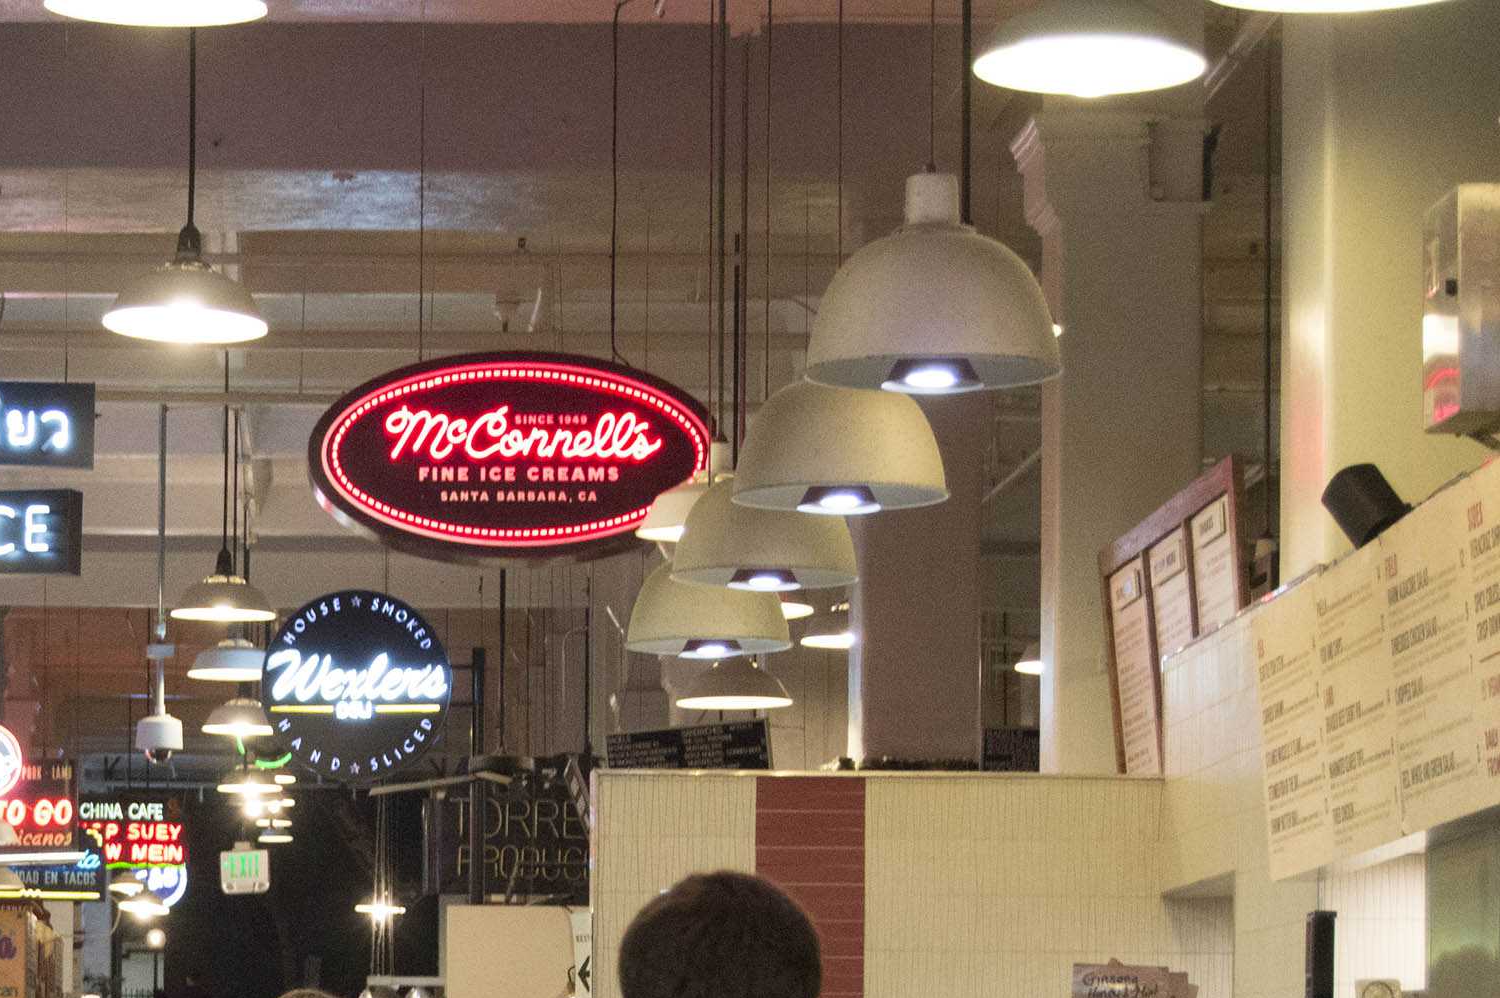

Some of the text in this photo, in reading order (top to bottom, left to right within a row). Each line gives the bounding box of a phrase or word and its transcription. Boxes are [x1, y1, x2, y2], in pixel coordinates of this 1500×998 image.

[514, 414, 555, 425] SINCE
[385, 405, 662, 460] McConnell's
[418, 466, 620, 482] FINE ICE CREAMS
[440, 490, 598, 504] SANTA BARBARA, CA
[283, 597, 433, 650] HOUSE SMOKED
[266, 648, 449, 702] Wexler's
[335, 700, 374, 721] DELI
[278, 718, 433, 772] HAND SLICED
[33, 799, 73, 826] GO
[80, 802, 164, 821] CHINA CAFE
[450, 797, 590, 840] TORRE
[127, 823, 182, 841] SUEY
[131, 843, 184, 862] MEIN
[458, 843, 590, 881] PRODUC
[44, 870, 59, 884] EN
[63, 870, 97, 885] TACOS
[229, 853, 260, 879] EXIT
